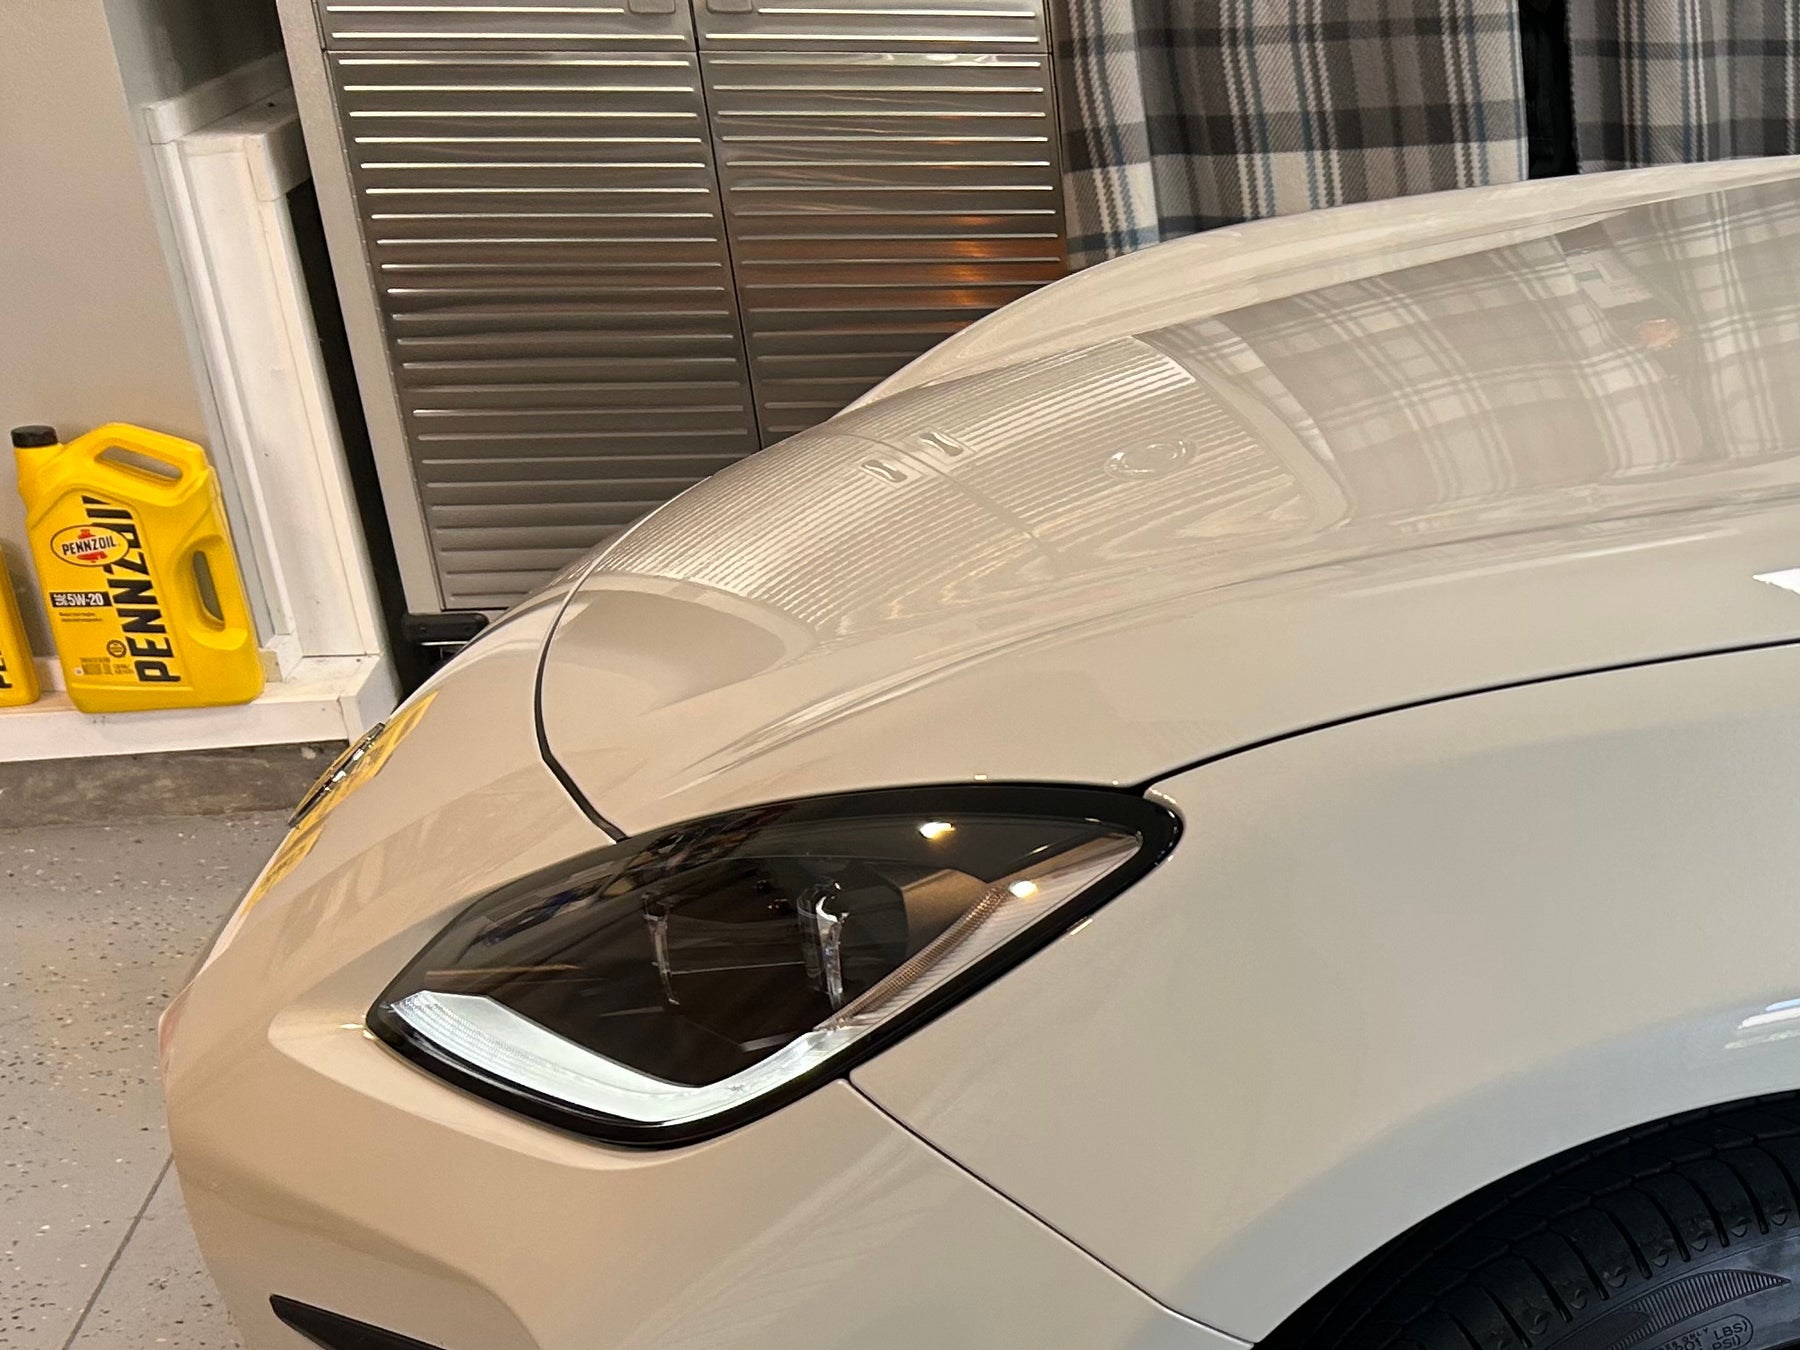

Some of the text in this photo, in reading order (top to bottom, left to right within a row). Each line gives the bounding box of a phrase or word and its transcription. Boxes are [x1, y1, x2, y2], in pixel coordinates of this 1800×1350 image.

[61, 535, 117, 556] PENNZOIL
[67, 593, 104, 606] 5W-20
[1713, 1320, 1748, 1340] LBS)
